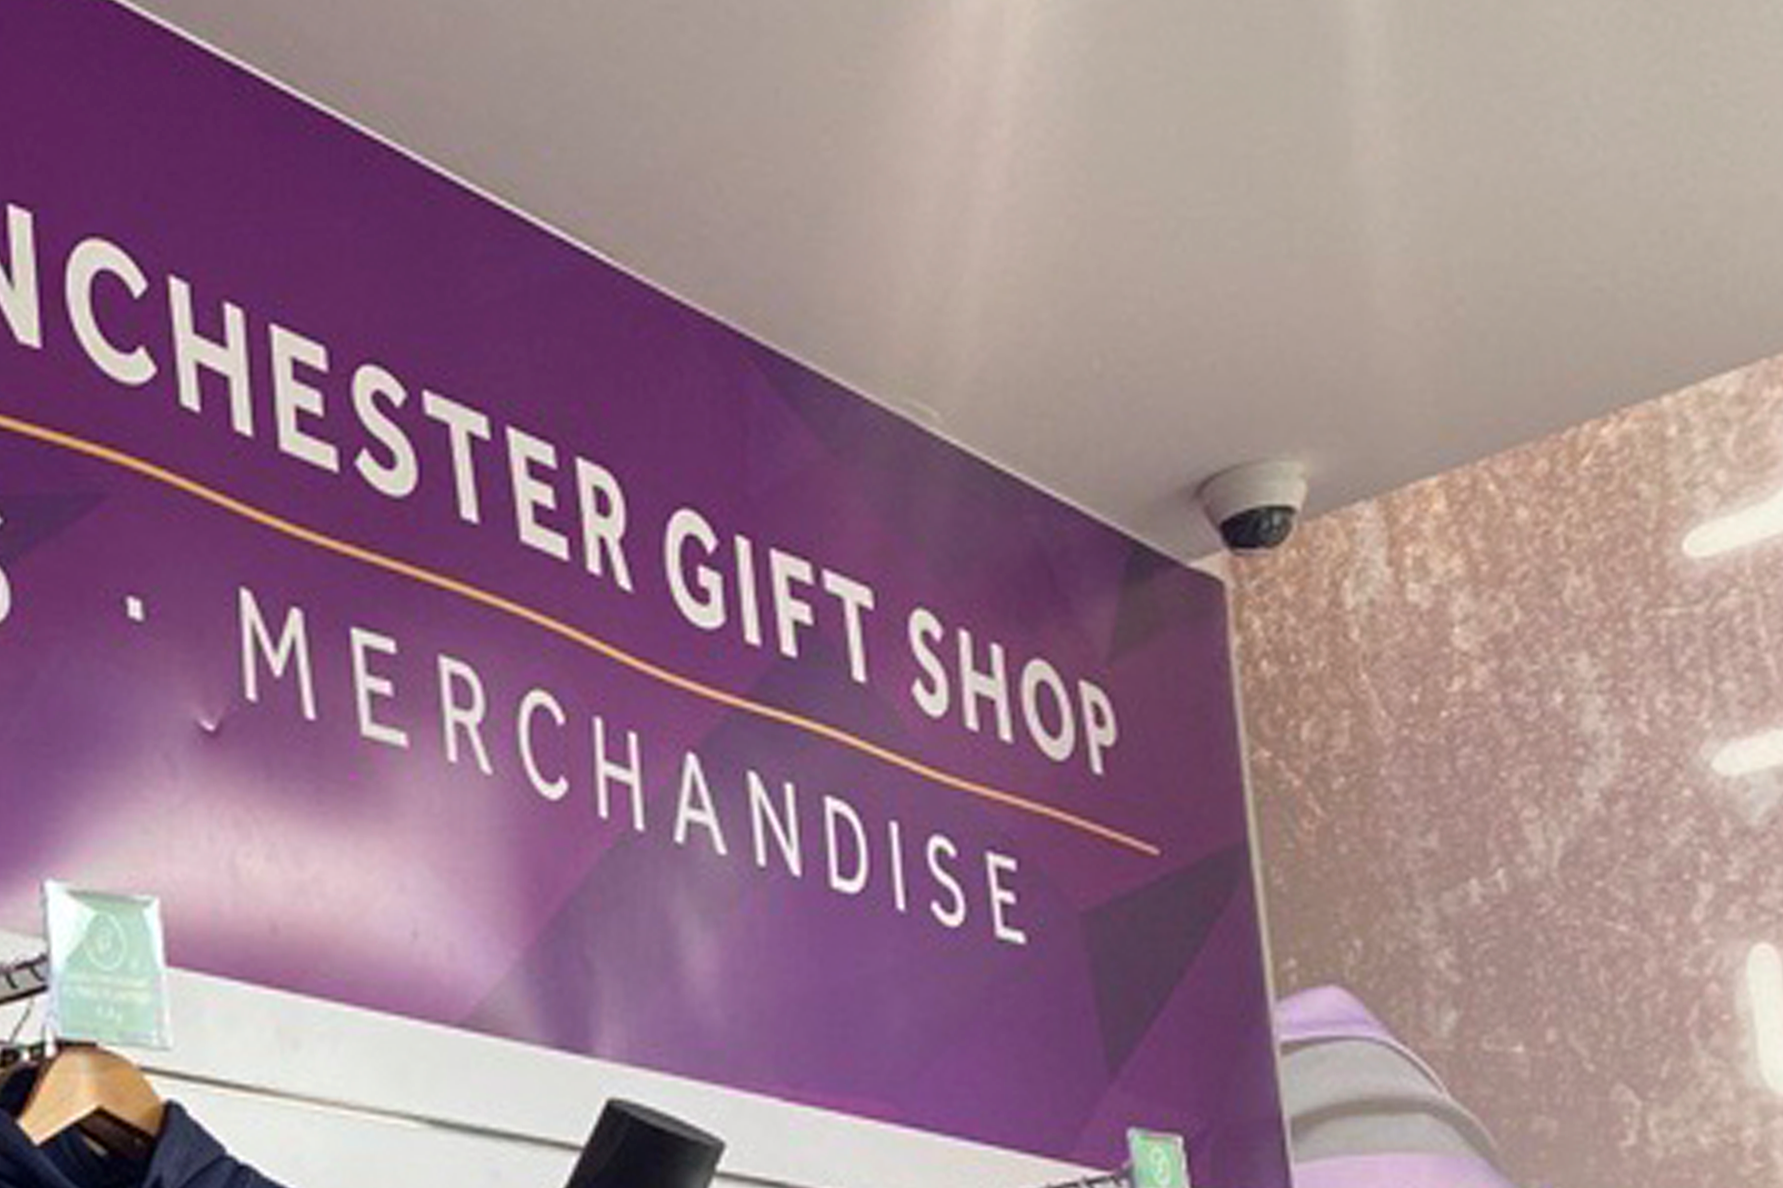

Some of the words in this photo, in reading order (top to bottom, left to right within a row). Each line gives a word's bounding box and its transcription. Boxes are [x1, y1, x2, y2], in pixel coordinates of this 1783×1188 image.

[240, 588, 1026, 945] MERCHANDISE
[664, 508, 875, 684] GIFT
[908, 607, 1118, 775] SHOP
